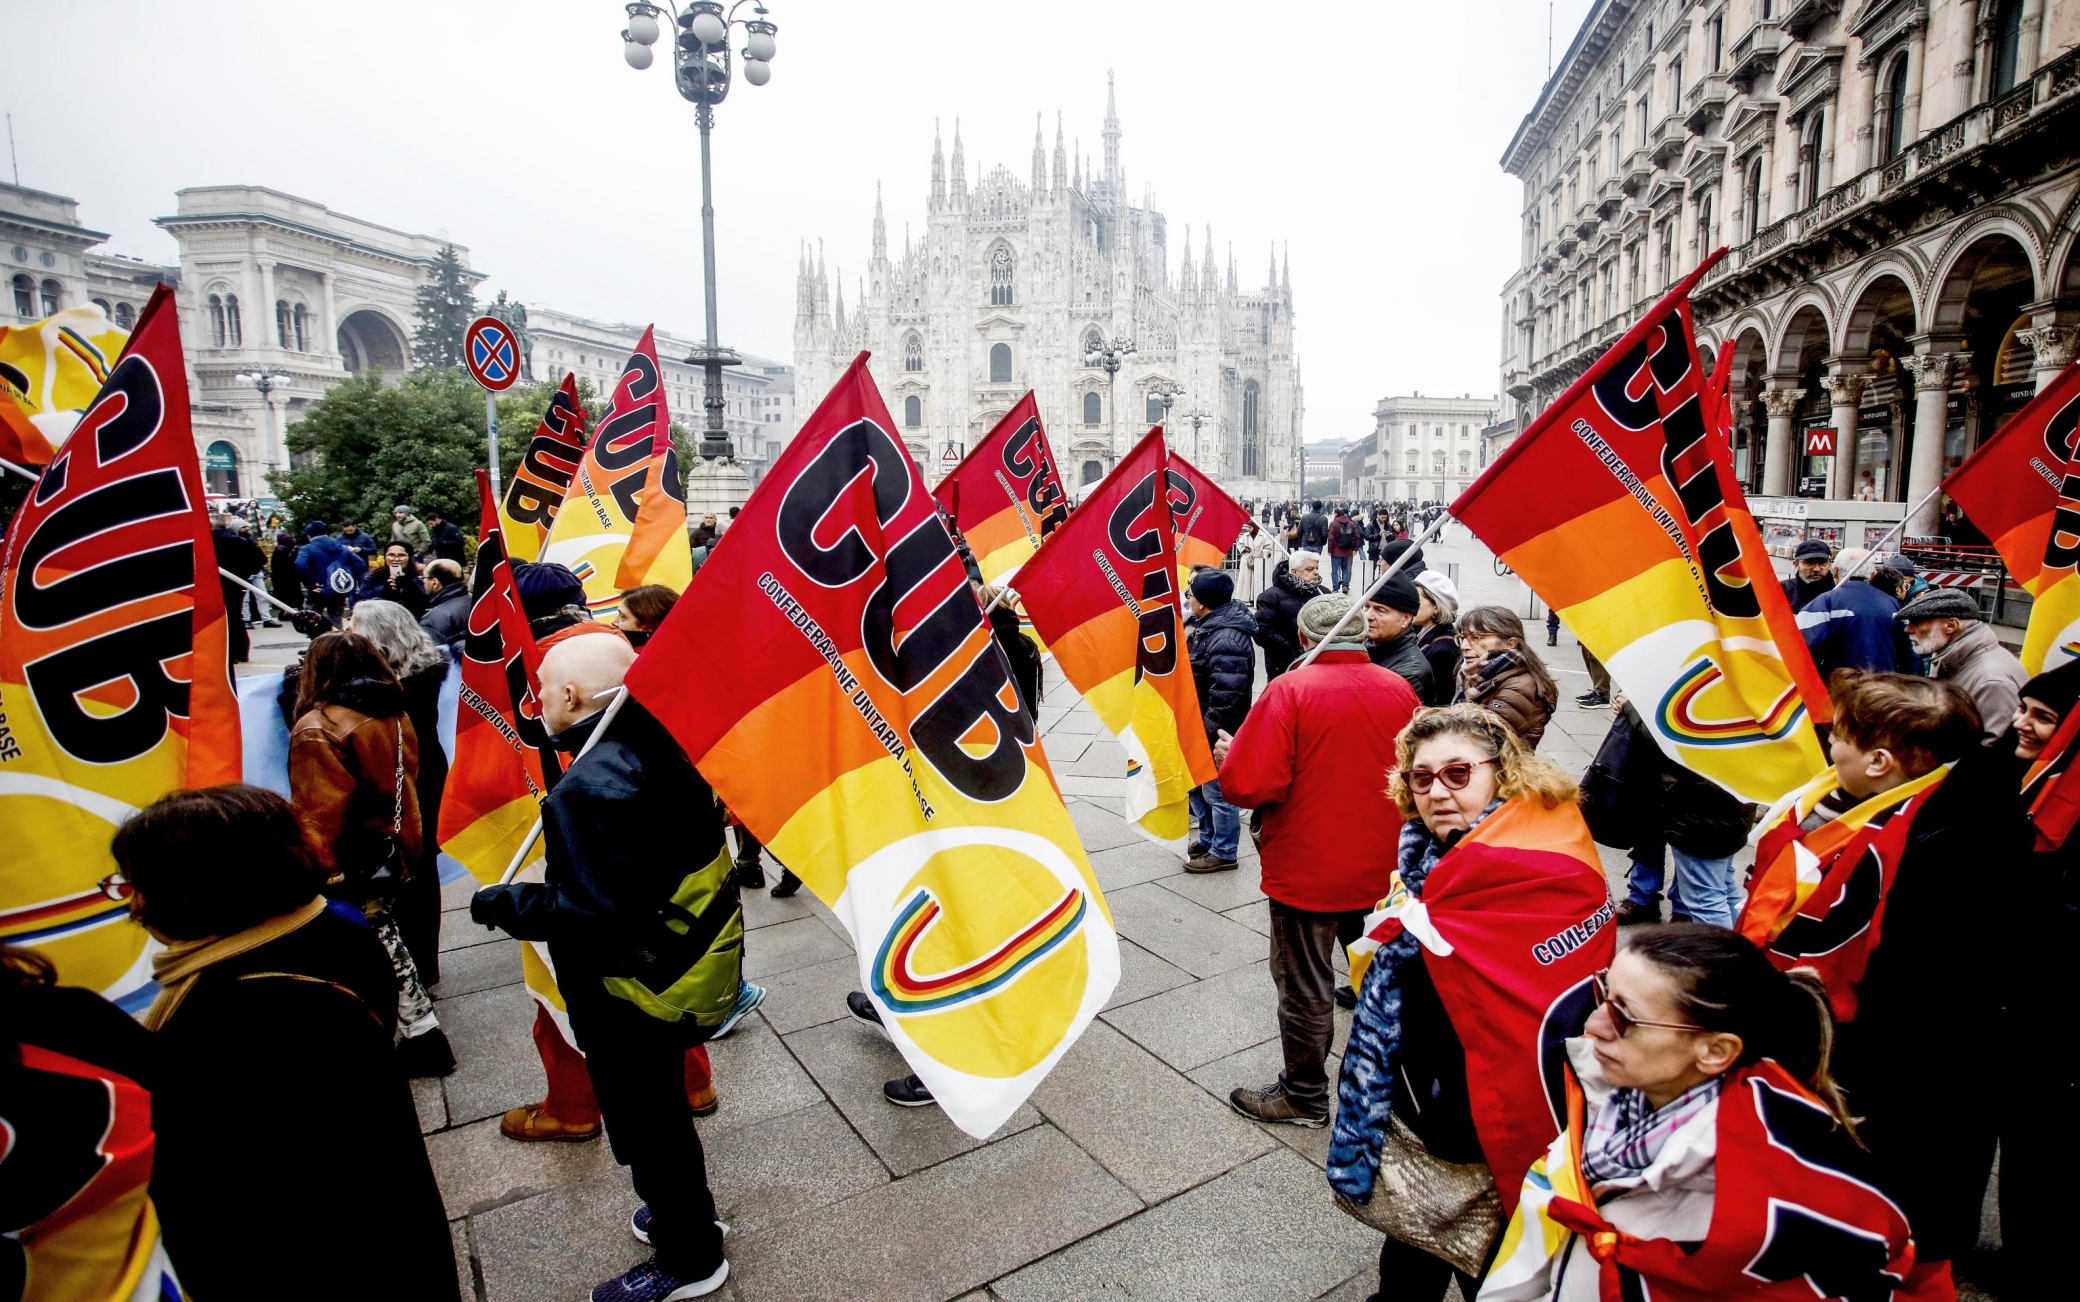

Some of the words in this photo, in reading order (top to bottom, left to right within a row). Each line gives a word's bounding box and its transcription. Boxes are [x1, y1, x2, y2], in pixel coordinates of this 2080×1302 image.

[591, 498, 602, 509] DI
[596, 507, 613, 531] BASE
[1571, 418, 1657, 512] CONFEDERAZIONE
[1651, 505, 1692, 565] UNITARIA
[1690, 566, 1700, 581] DI
[776, 417, 1036, 803] CUB
[1092, 548, 1142, 622] CONFEDERAZION
[459, 680, 518, 743] DERAZIONE
[757, 571, 859, 696] CONFEDERAZIONE
[852, 688, 906, 762] UNITARIA
[902, 758, 913, 778] DI
